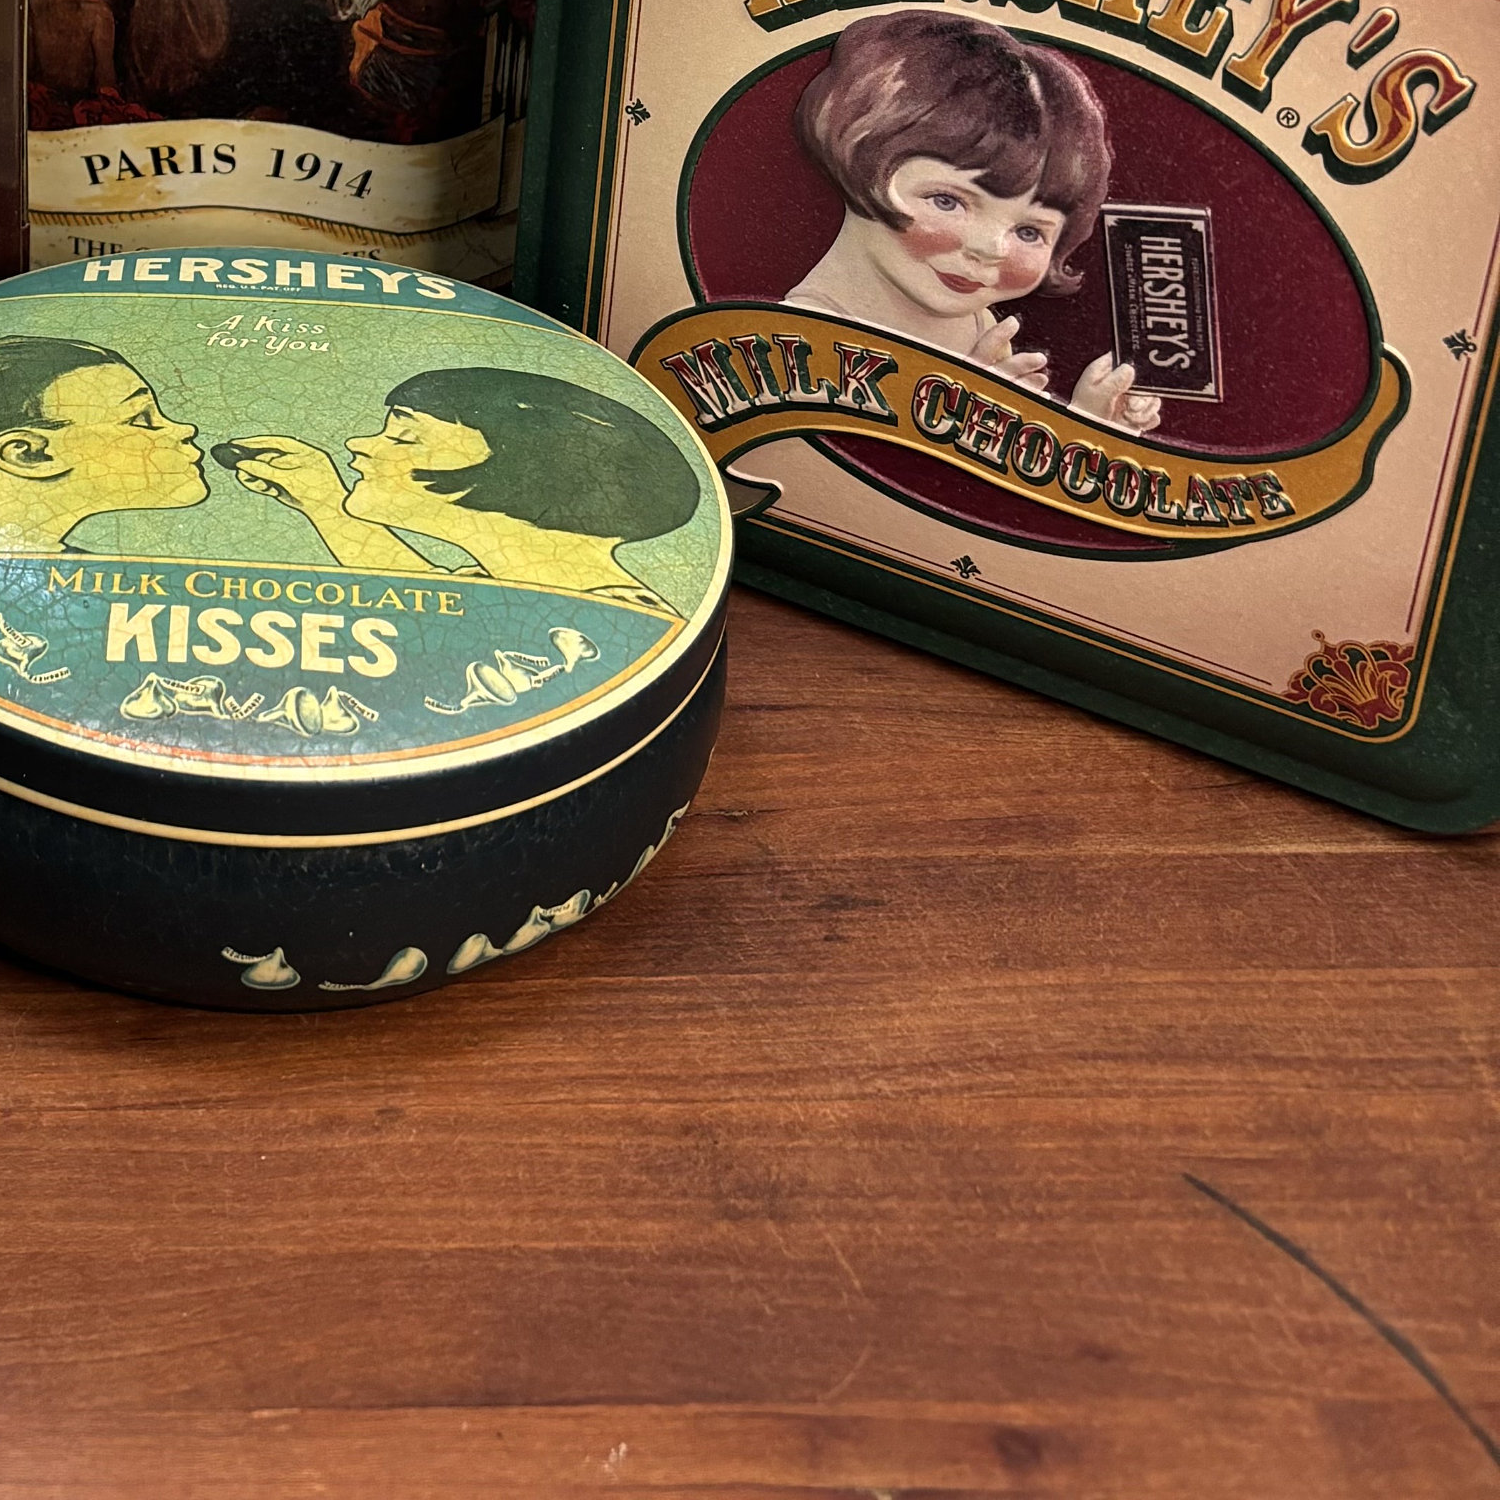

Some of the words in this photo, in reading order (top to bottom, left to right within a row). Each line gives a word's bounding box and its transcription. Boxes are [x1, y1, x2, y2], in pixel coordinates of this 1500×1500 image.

[81, 143, 238, 186] PARIS
[265, 148, 375, 200] 1914
[83, 257, 457, 300] HERSHEY'S
[1140, 236, 1196, 369] HERSHEY'S
[196, 315, 237, 331] A
[252, 315, 327, 336] Kiss
[206, 331, 258, 350] for
[264, 334, 331, 357] You
[663, 332, 899, 431] MILK
[911, 371, 1296, 529] CHOCOLATE
[46, 564, 167, 596] MILK
[184, 569, 465, 617] CHOCOLATE
[104, 604, 401, 679] KISSES
